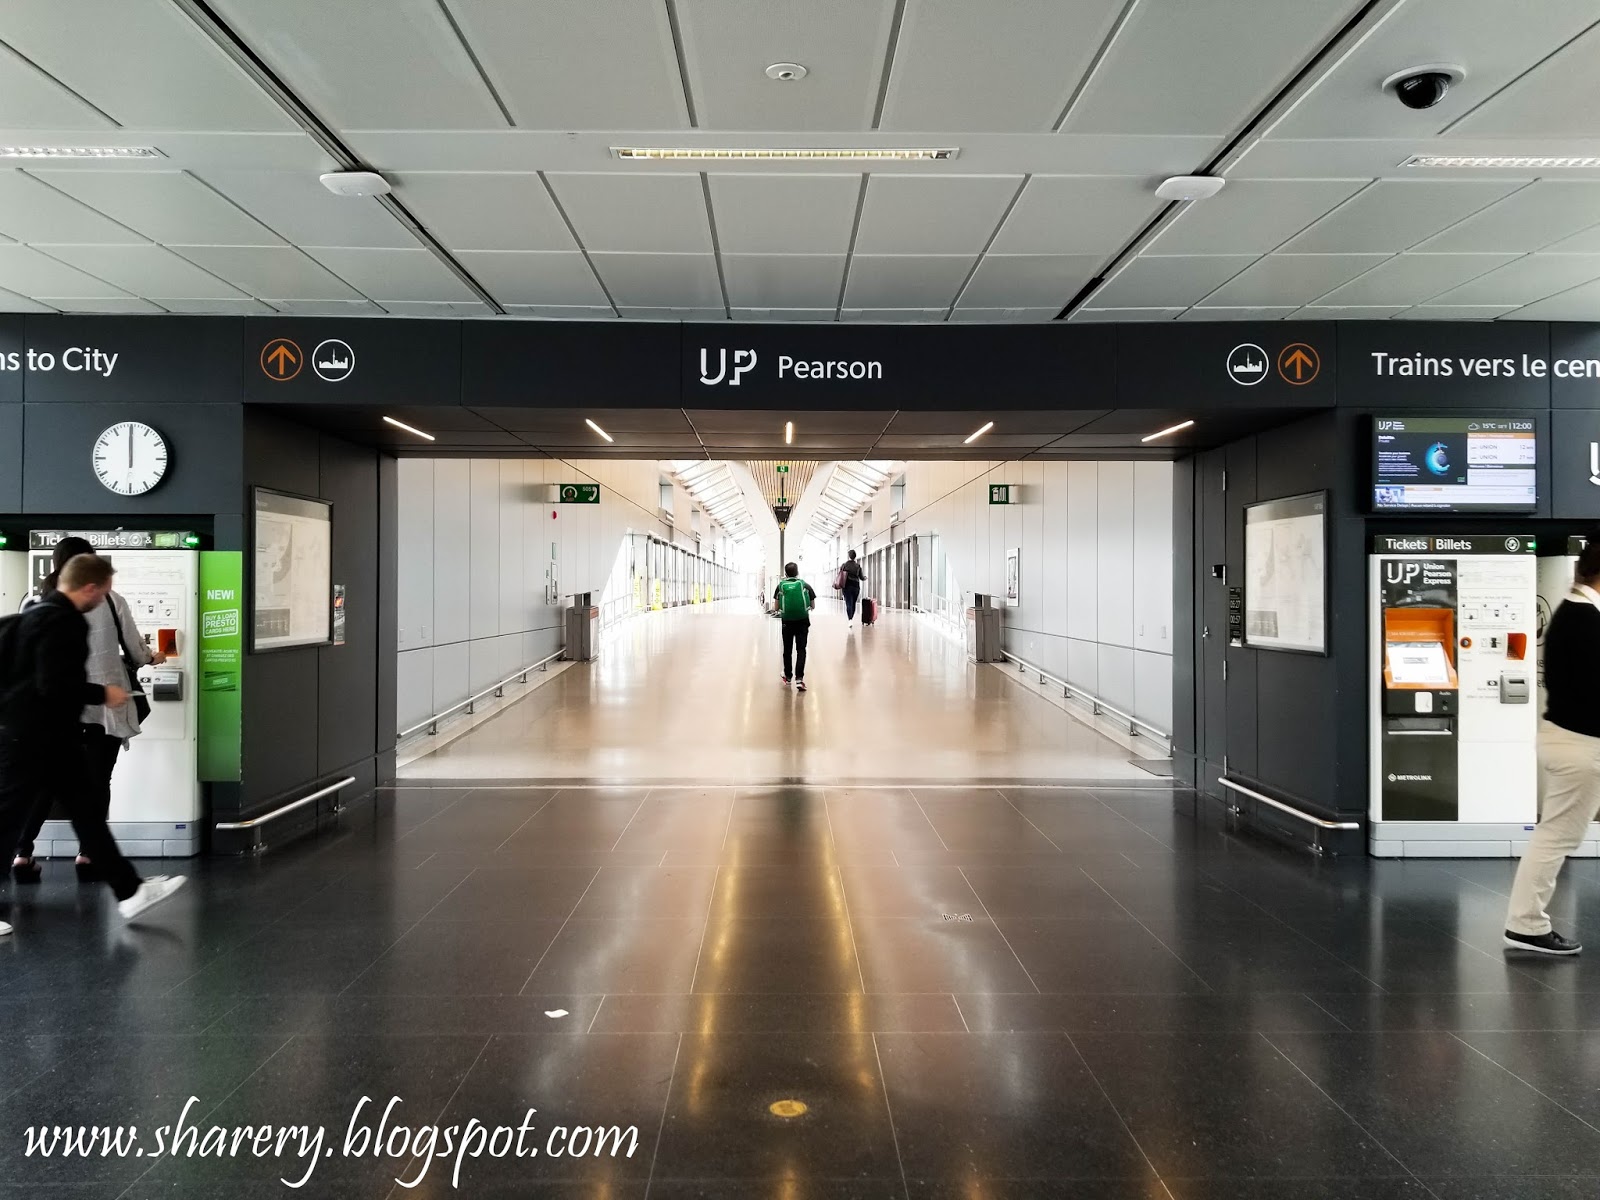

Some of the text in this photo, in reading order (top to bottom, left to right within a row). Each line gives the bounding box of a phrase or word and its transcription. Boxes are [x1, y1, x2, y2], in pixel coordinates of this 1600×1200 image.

[26, 348, 55, 371] to
[62, 347, 119, 377] City
[700, 348, 882, 386] UP Pearson
[1371, 352, 1453, 376] Trains
[1459, 358, 1515, 377] vers
[1522, 354, 1547, 377] le
[1512, 422, 1532, 430] 12:00
[89, 534, 127, 546] Billets
[1386, 538, 1472, 550] Tickets Billets
[1387, 562, 1420, 584] UP
[207, 589, 234, 600] NEW!
[222, 612, 237, 620] LOAD
[205, 619, 236, 628] PRESTO
